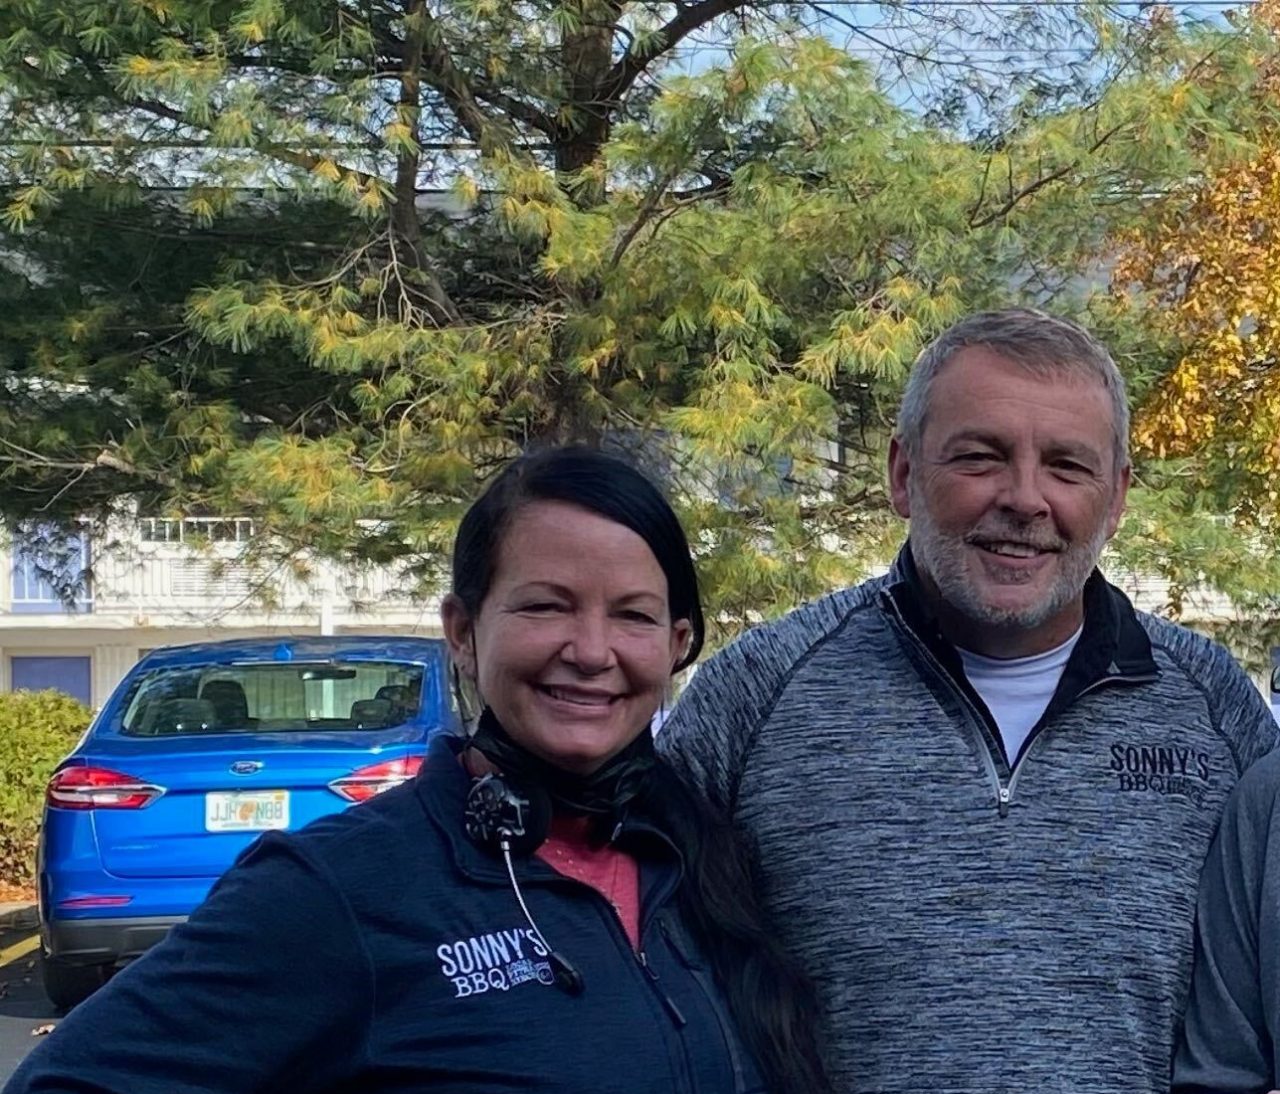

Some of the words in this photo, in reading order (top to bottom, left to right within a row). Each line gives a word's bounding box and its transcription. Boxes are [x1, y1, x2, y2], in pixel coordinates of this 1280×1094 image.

[1110, 743, 1209, 781] SONNY'S
[1119, 773, 1166, 795] BBQ
[437, 928, 548, 976] SONNY'S
[451, 968, 510, 998] BBQ
